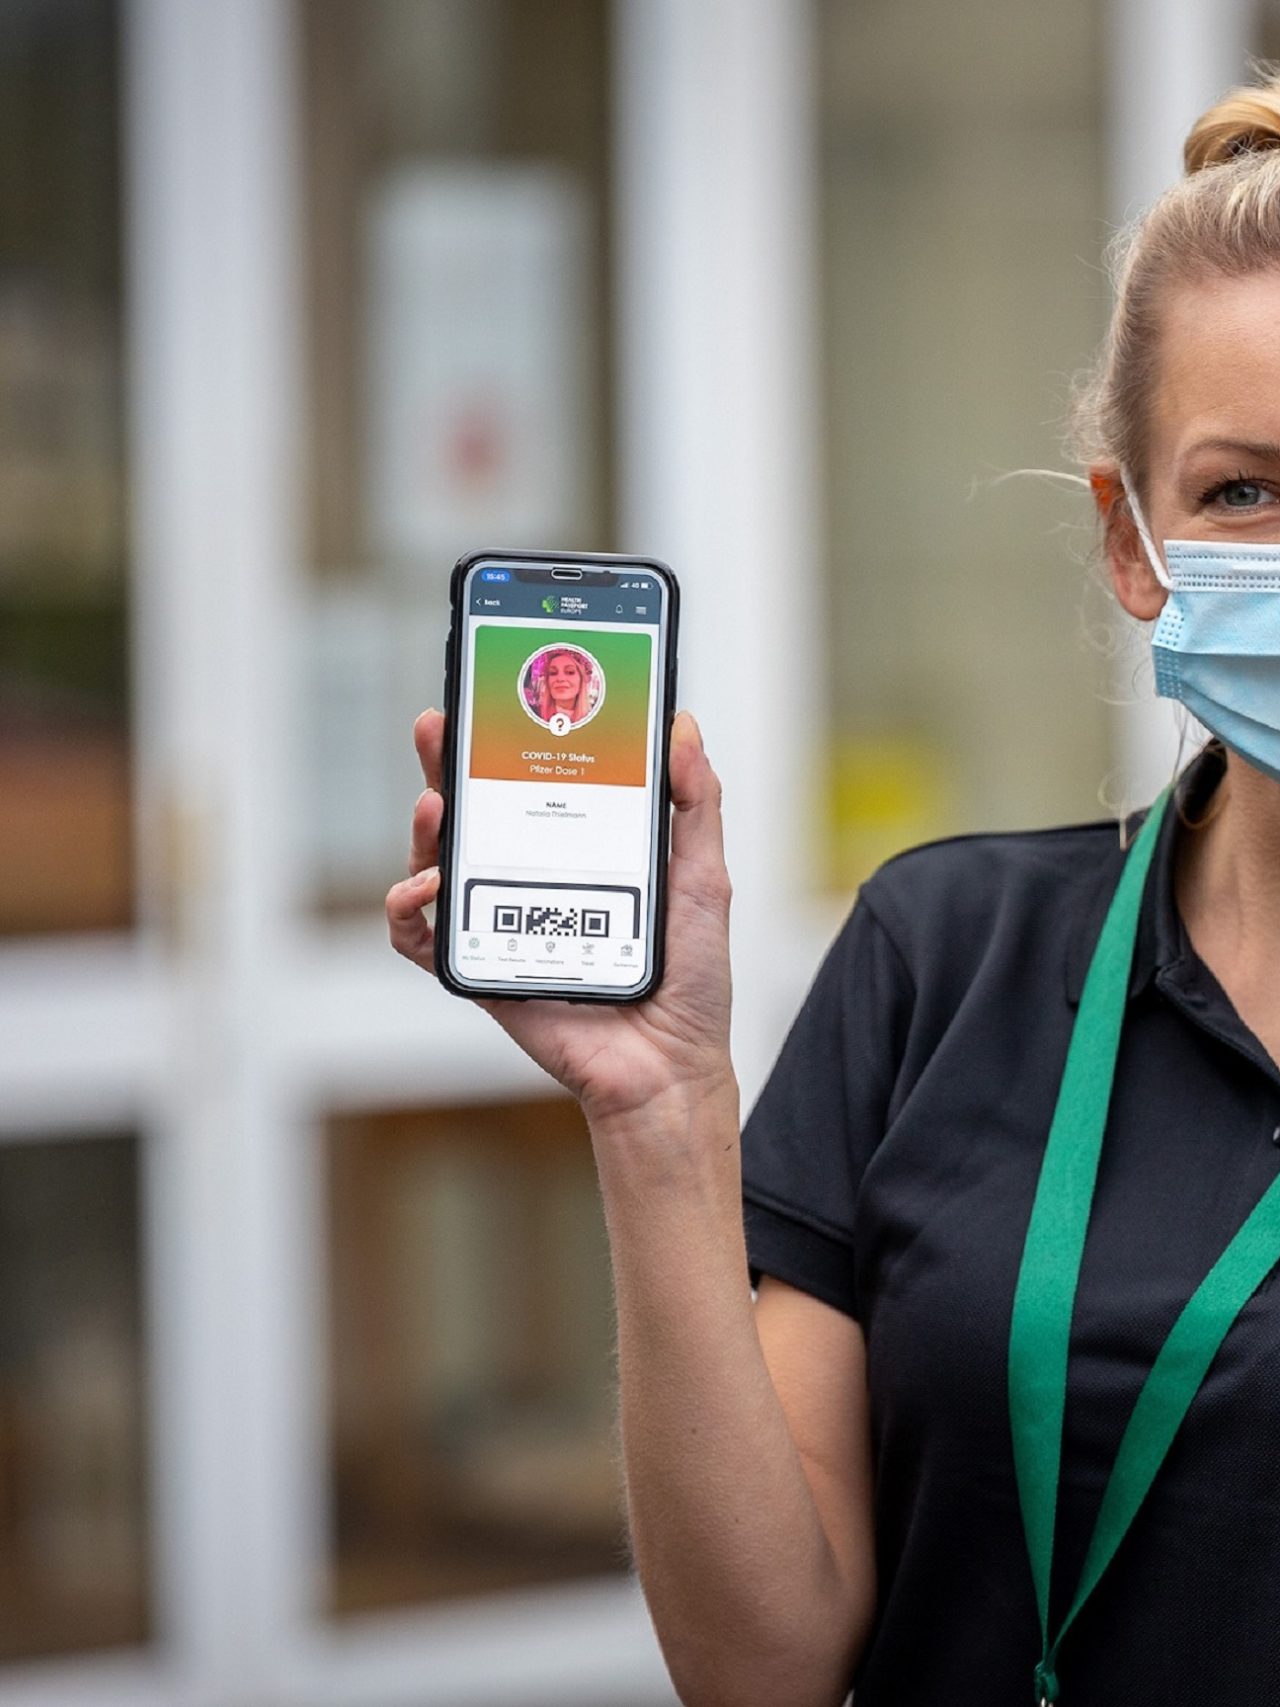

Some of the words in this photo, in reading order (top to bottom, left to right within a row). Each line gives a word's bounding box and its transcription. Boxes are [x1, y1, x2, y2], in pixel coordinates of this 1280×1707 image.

[521, 751, 567, 761] COVID-19
[568, 753, 595, 763] Status
[529, 764, 553, 774] Pfizer
[555, 765, 578, 776] Dose
